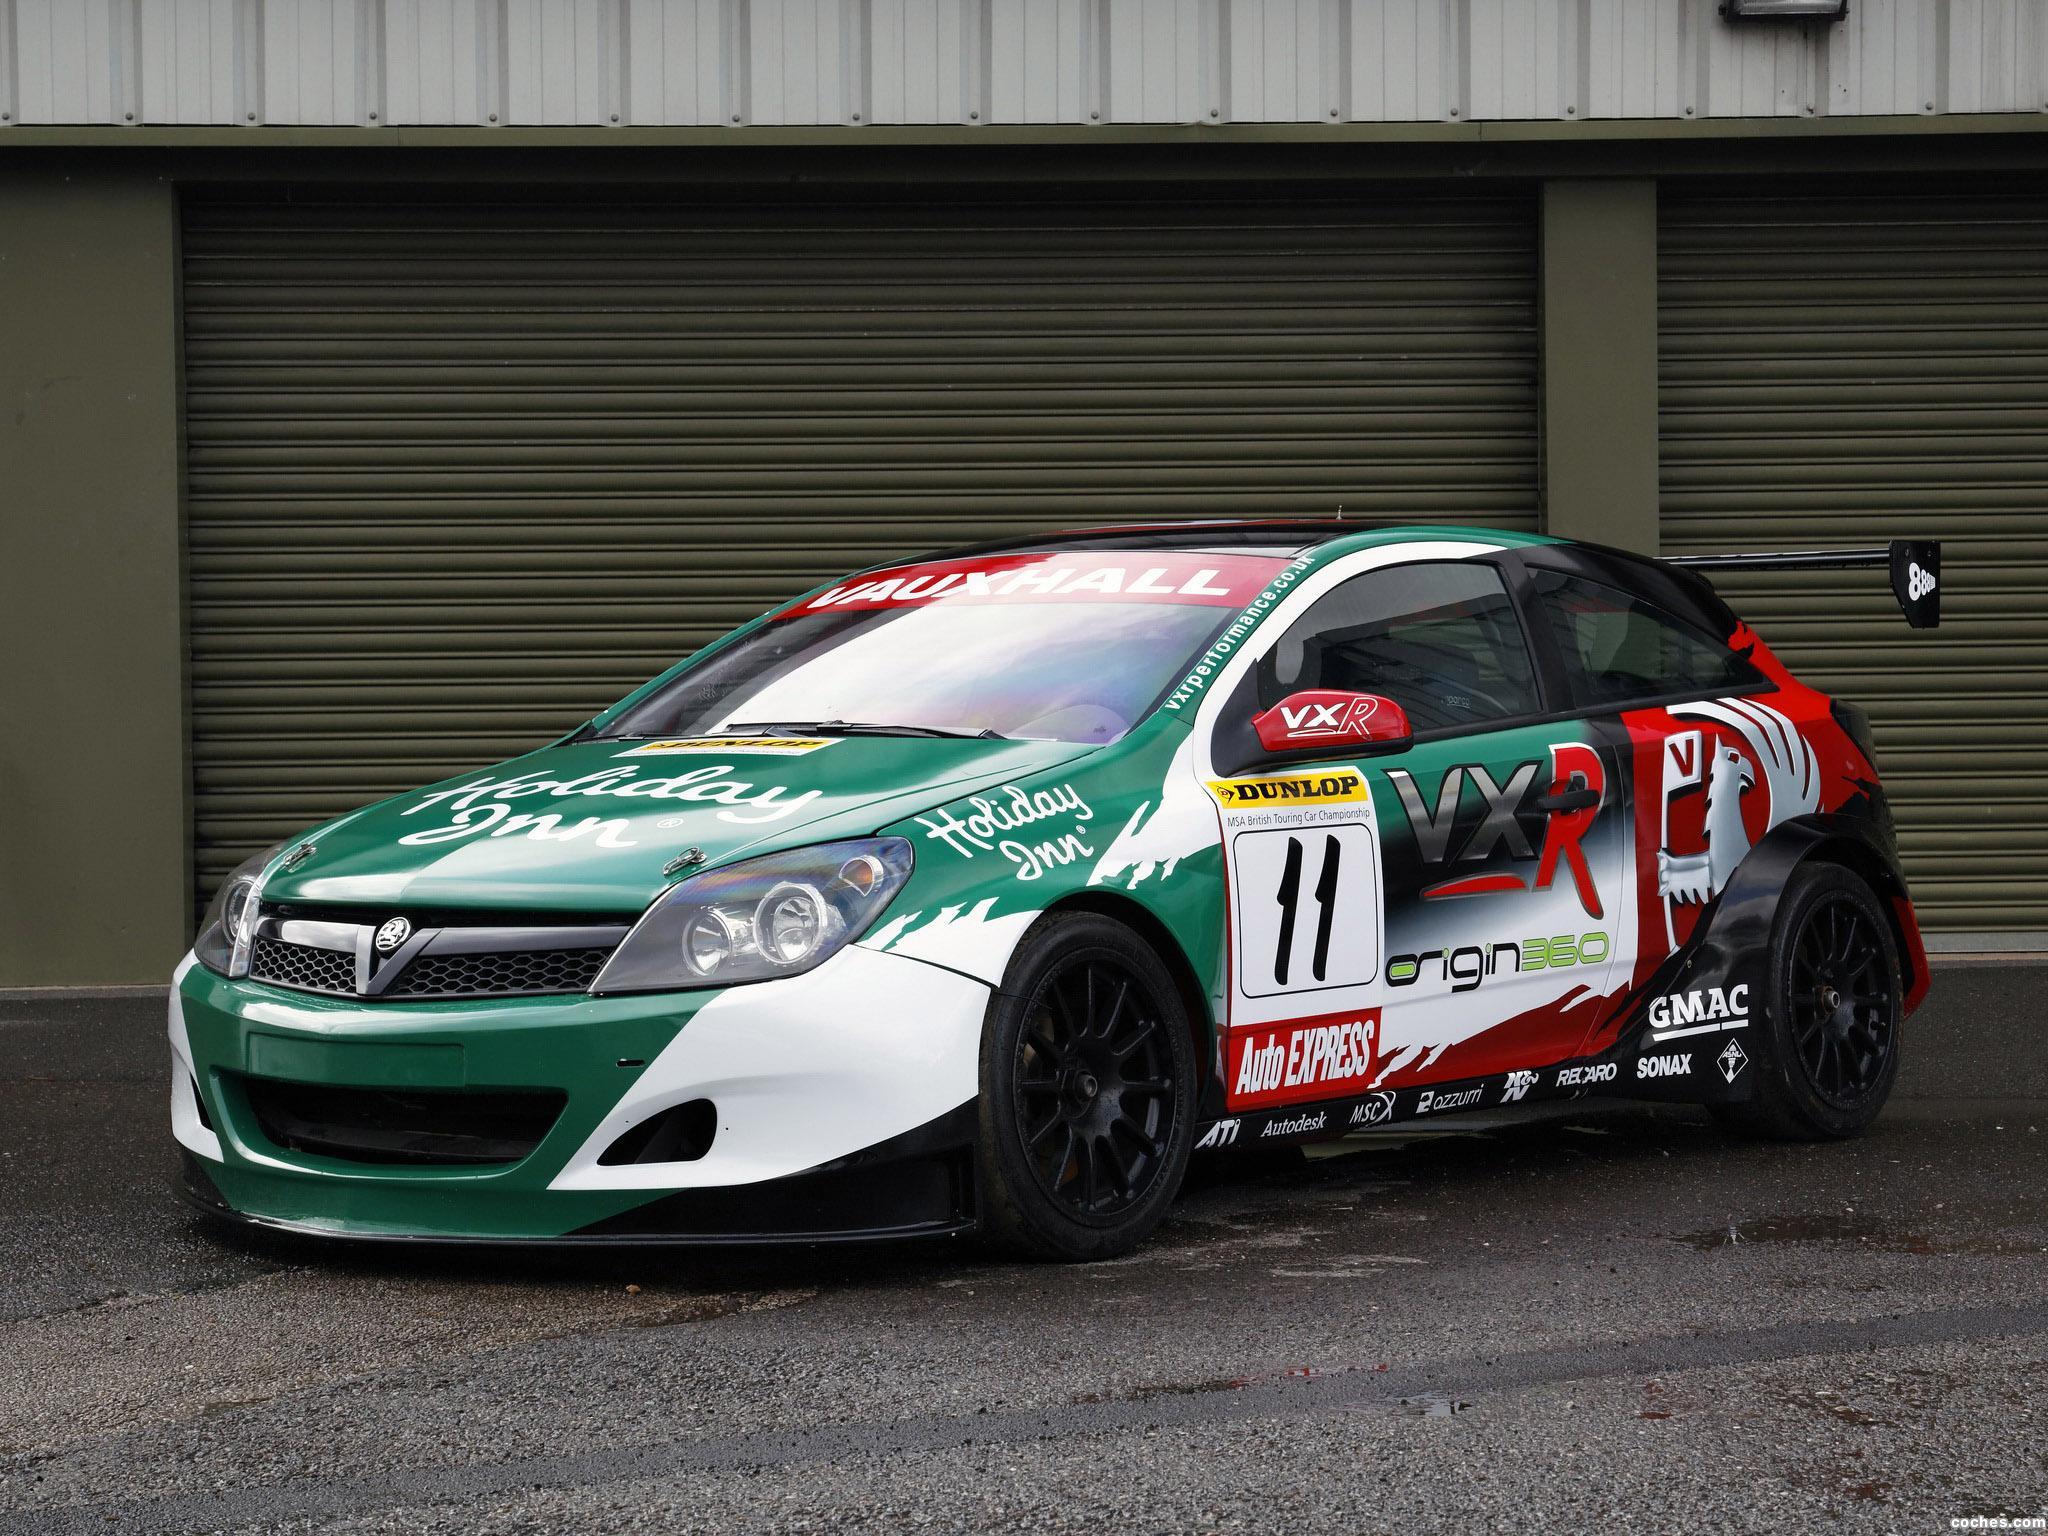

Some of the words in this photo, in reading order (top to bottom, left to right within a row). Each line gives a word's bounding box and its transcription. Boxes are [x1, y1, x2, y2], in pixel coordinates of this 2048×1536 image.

[807, 567, 1231, 609] VAUXHALL
[1164, 555, 1316, 711] vxrperformance.co.uk
[1280, 697, 1378, 741] VXR
[400, 765, 823, 824] Holiday
[1233, 775, 1359, 801] DUNLOP
[397, 804, 639, 848] Inn
[914, 783, 1094, 859] Holiday
[1227, 816, 1246, 828] MSA
[1247, 813, 1272, 826] British
[1273, 811, 1303, 825] Touring
[1304, 811, 1317, 823] Car
[1318, 808, 1371, 822] Championship
[1381, 741, 1606, 920] VXR
[999, 833, 1094, 881] Inn
[1274, 834, 1341, 986] 11
[1385, 931, 1610, 994] origin360
[1649, 984, 1749, 1029] GMAC
[1235, 1034, 1285, 1095] Auto
[1284, 1019, 1375, 1087] EXPRESS
[1556, 1062, 1618, 1087] RECARO
[1637, 1053, 1693, 1079] SONAX
[1194, 1118, 1241, 1150] ATI
[1260, 1110, 1328, 1138] Autodesk
